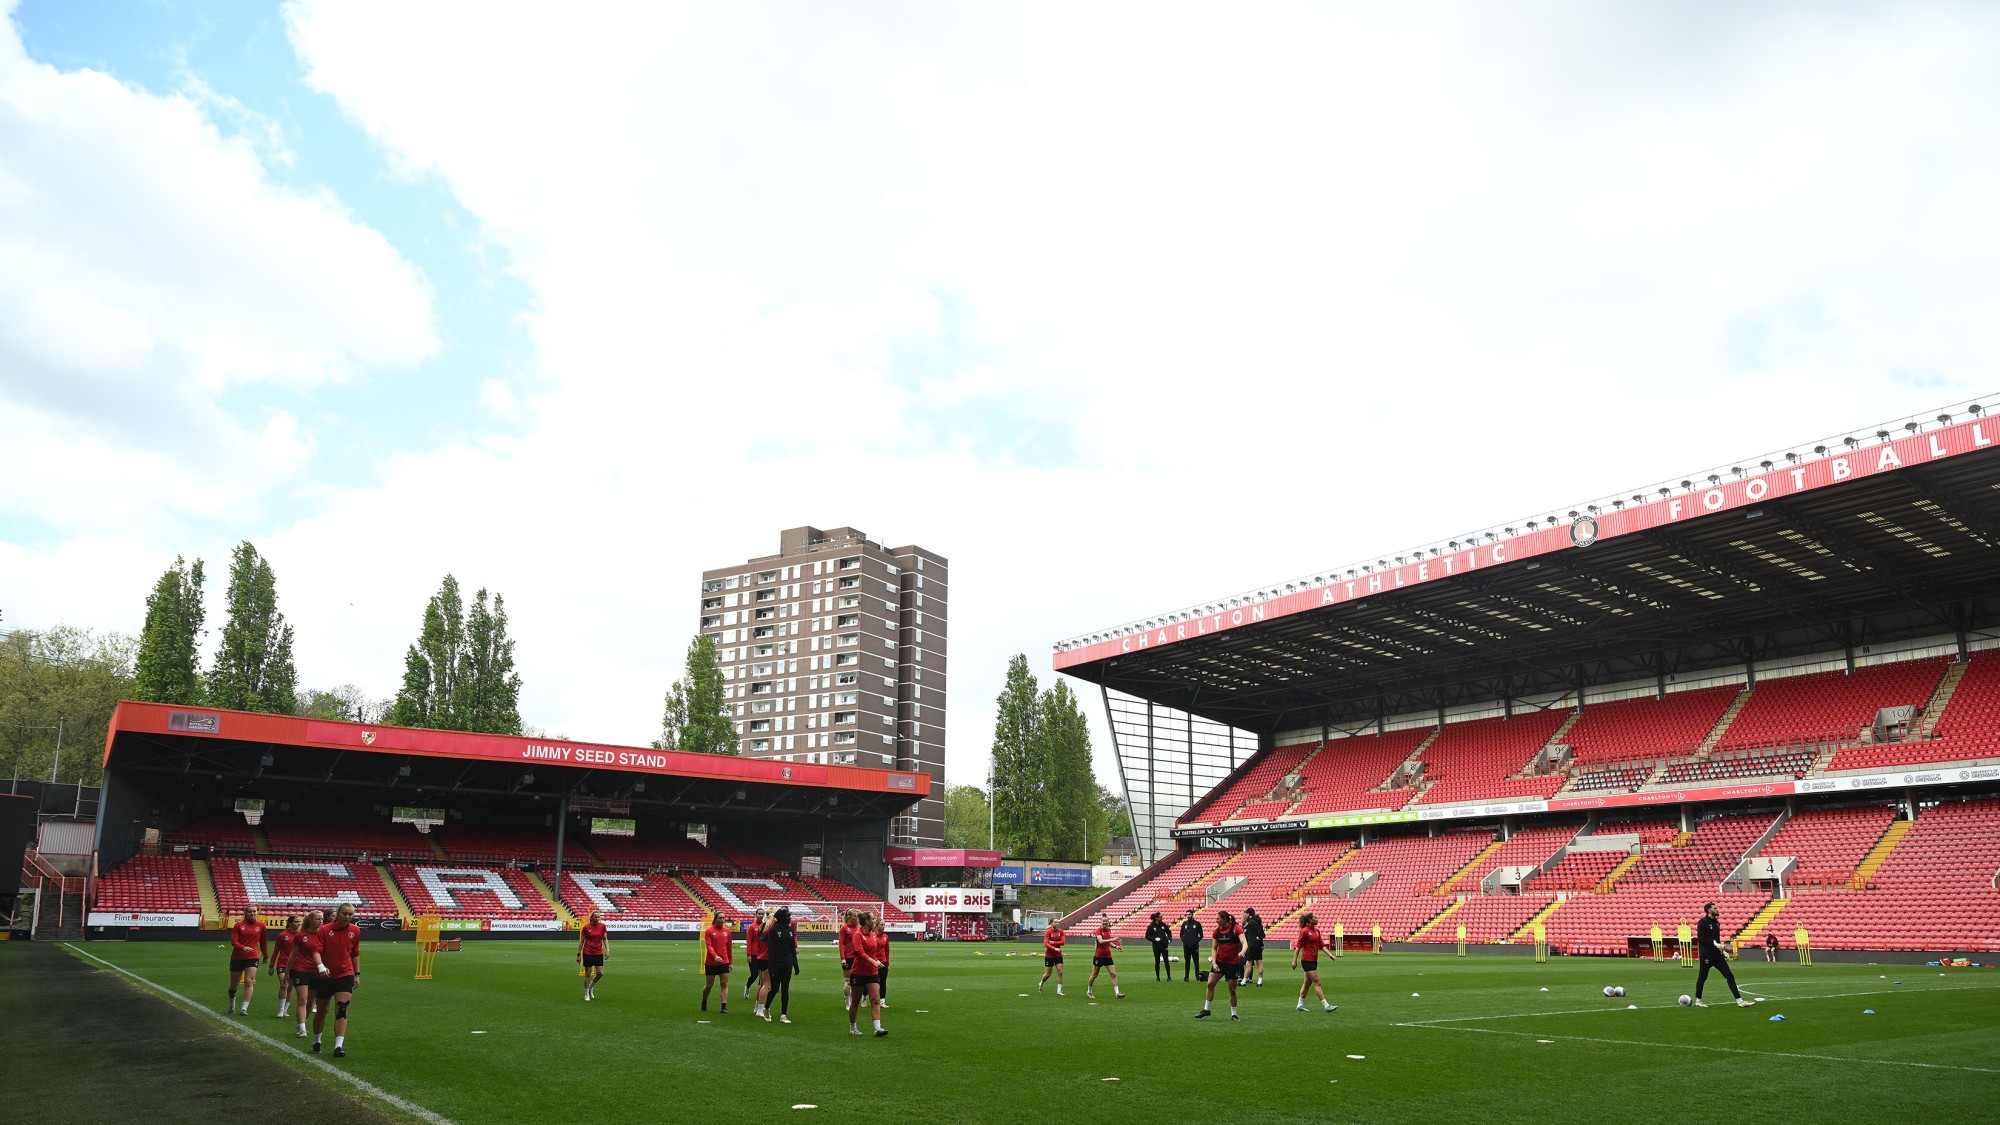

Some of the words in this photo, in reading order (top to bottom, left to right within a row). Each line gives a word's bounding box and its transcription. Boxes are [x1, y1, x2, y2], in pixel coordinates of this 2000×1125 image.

[1122, 604, 1264, 652] CHARLTON
[1321, 543, 1506, 605] ATHLETIC
[1670, 424, 1990, 520] FOOTBALL
[1863, 645, 1870, 654] M
[1891, 709, 1905, 718] 10
[522, 745, 571, 760] JIMMY
[575, 749, 615, 764] SEED
[619, 752, 667, 768] STAND
[1515, 871, 1521, 880] 3
[1766, 864, 1775, 874] 4
[898, 892, 917, 908] axis
[924, 892, 958, 909] axis
[963, 892, 991, 909] axis
[139, 914, 175, 922] Insurance
